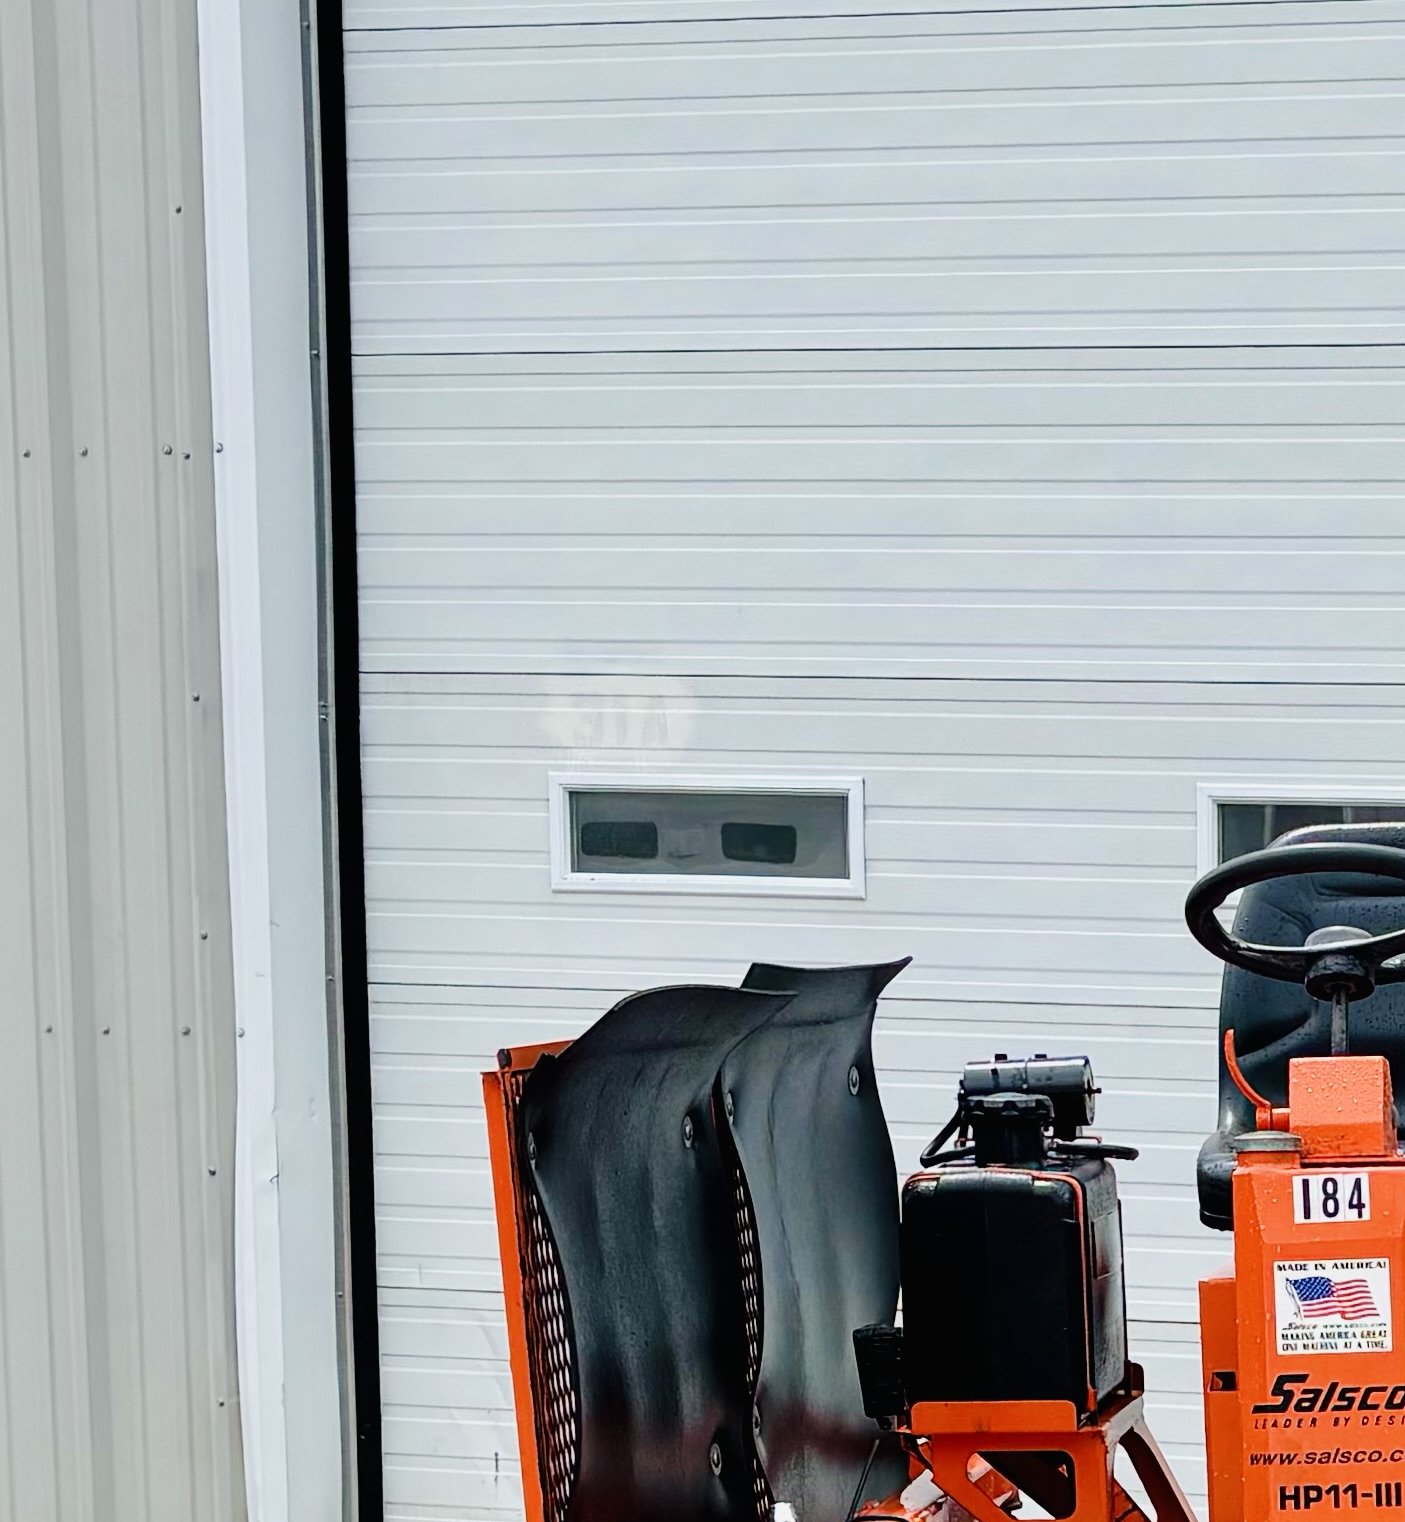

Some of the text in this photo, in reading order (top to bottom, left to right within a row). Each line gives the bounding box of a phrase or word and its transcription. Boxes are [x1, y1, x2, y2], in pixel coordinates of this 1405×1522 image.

[1302, 1177, 1366, 1220] 184
[1277, 1263, 1308, 1272] MADE
[1314, 1263, 1326, 1271] IN
[1254, 1418, 1318, 1430] LEADER
[1333, 1416, 1351, 1428] BY
[1279, 1482, 1403, 1511] HP11-III
